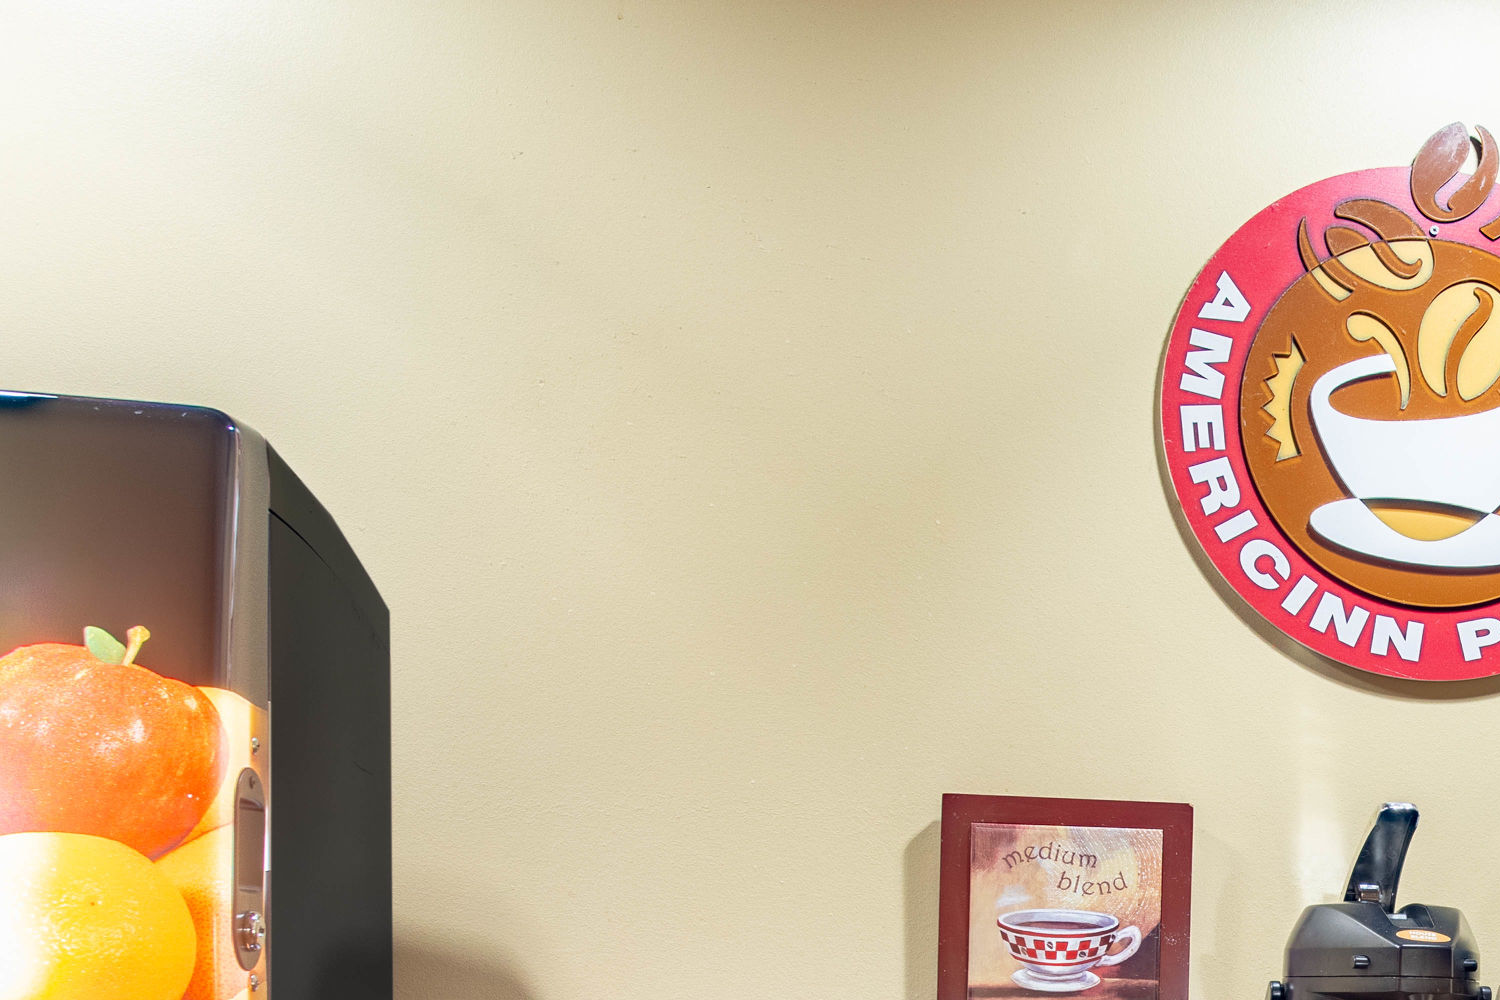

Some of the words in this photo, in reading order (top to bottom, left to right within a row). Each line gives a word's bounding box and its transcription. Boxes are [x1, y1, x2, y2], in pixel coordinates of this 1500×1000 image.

[1179, 270, 1425, 662] AMERICINN
[1001, 841, 1098, 870] medium
[1056, 871, 1129, 897] blend
